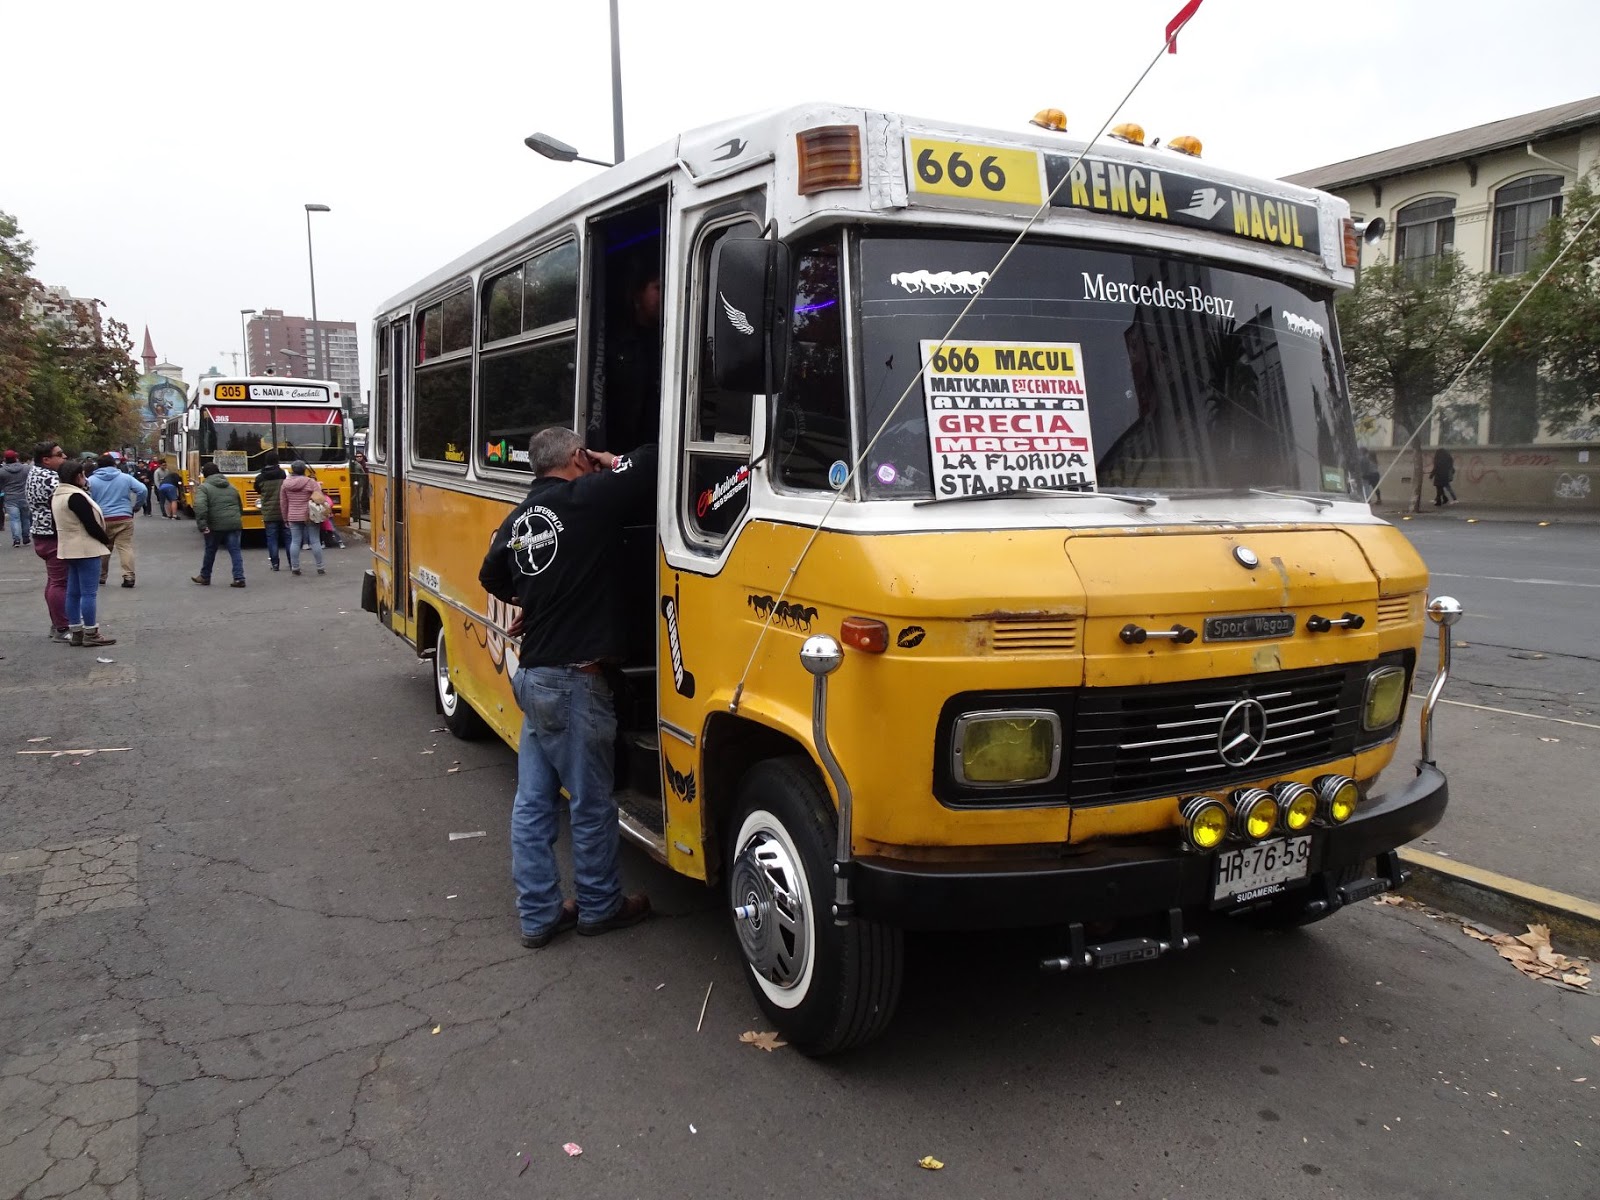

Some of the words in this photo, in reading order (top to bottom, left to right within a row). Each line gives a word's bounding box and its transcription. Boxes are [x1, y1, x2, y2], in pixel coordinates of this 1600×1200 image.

[916, 148, 1006, 192] 666
[1069, 157, 1169, 220] RENCA
[1231, 189, 1304, 248] MACUL
[1080, 271, 1236, 319] Mercedes-Benz
[932, 347, 980, 373] 666
[994, 349, 1074, 372] MACUL
[221, 386, 241, 397] 305
[252, 388, 261, 396] C.
[262, 388, 284, 397] NAVIA
[930, 377, 1010, 393] MATUCANA
[1027, 379, 1084, 395] CENTRAL
[938, 414, 1074, 433] GRECIA
[940, 437, 1086, 451] MACUL
[942, 453, 977, 470] LA
[985, 452, 1089, 471] FLORIDA
[1214, 620, 1248, 637] Sport
[1255, 617, 1289, 634] Wagon
[666, 600, 684, 691] SUBIDA
